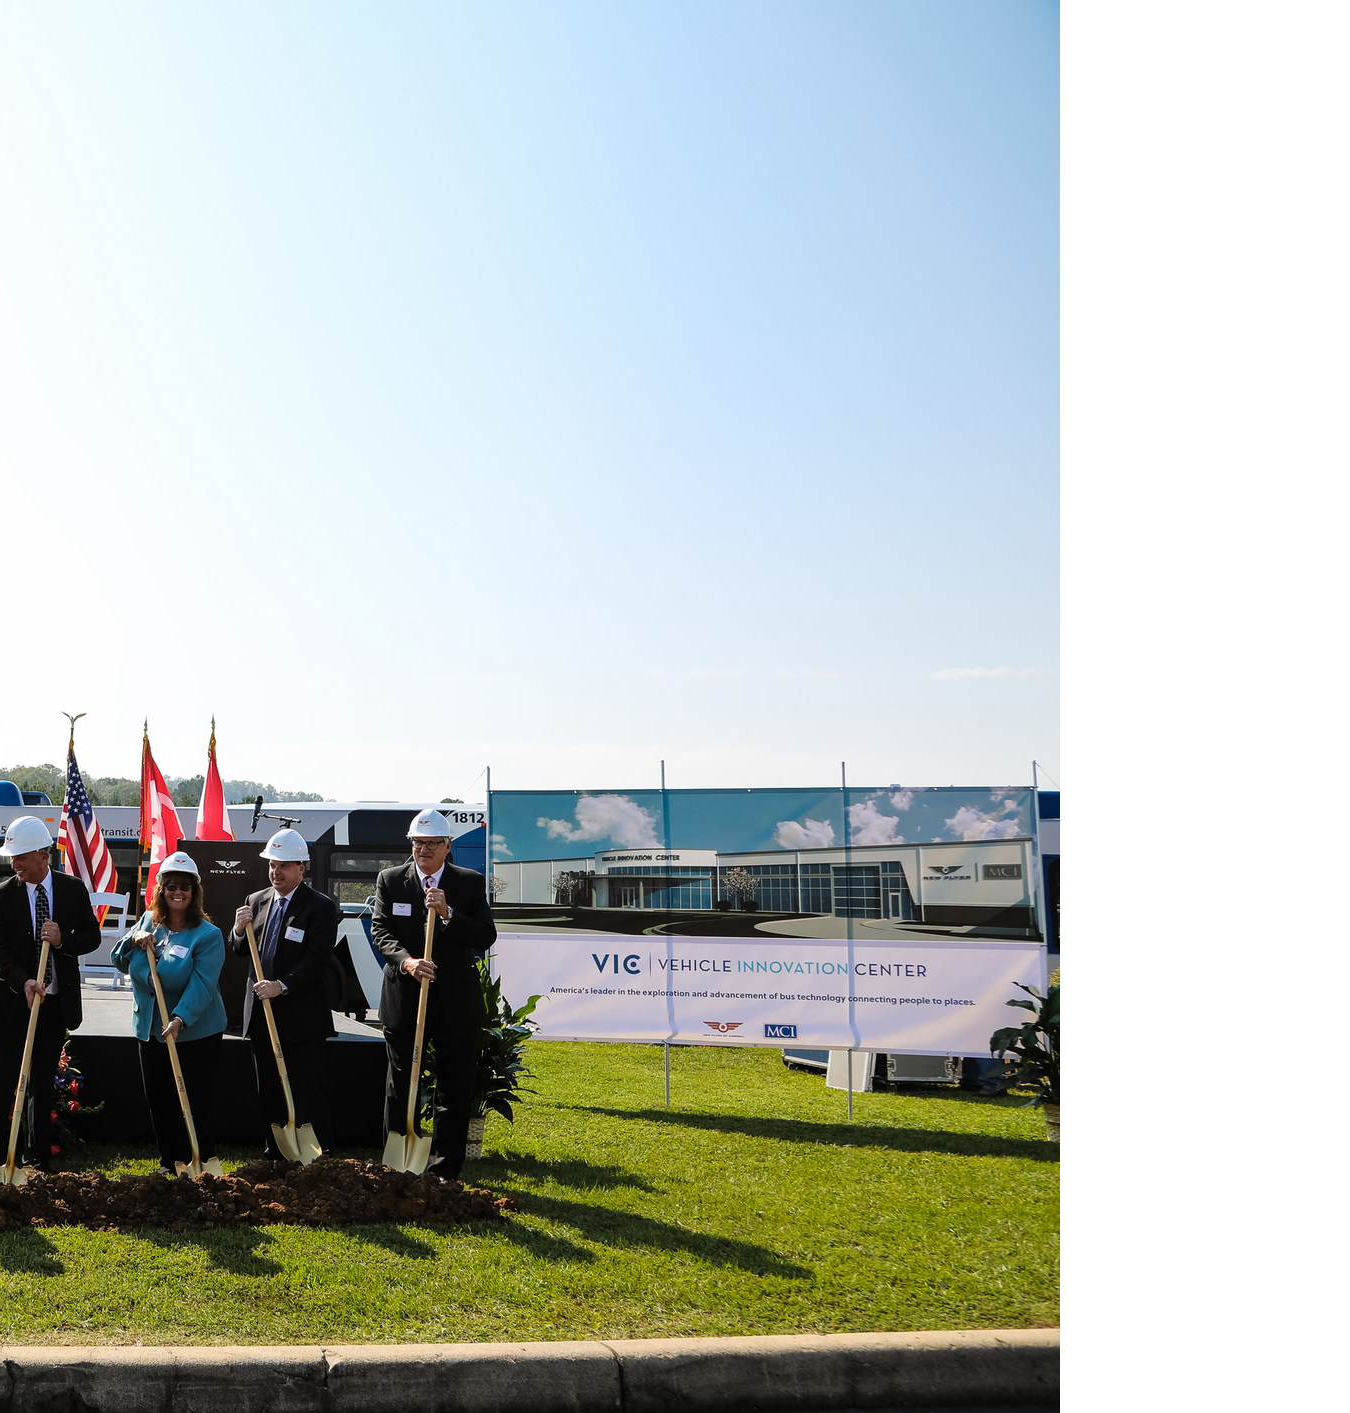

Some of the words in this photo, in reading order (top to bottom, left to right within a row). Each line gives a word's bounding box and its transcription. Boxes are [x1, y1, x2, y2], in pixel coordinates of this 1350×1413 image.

[452, 812, 484, 824] 1812
[989, 866, 1018, 876] MCI
[592, 954, 641, 975] VIC
[658, 958, 732, 972] VEHICLE
[738, 960, 848, 975] INNOVATION
[854, 963, 927, 978] CENTER
[642, 990, 690, 998] exploration
[710, 991, 767, 1000] advancement
[797, 994, 846, 1003] technology
[848, 996, 897, 1005] connecting
[900, 997, 930, 1006] people
[944, 998, 976, 1006] places.
[766, 1026, 795, 1038] MCI
